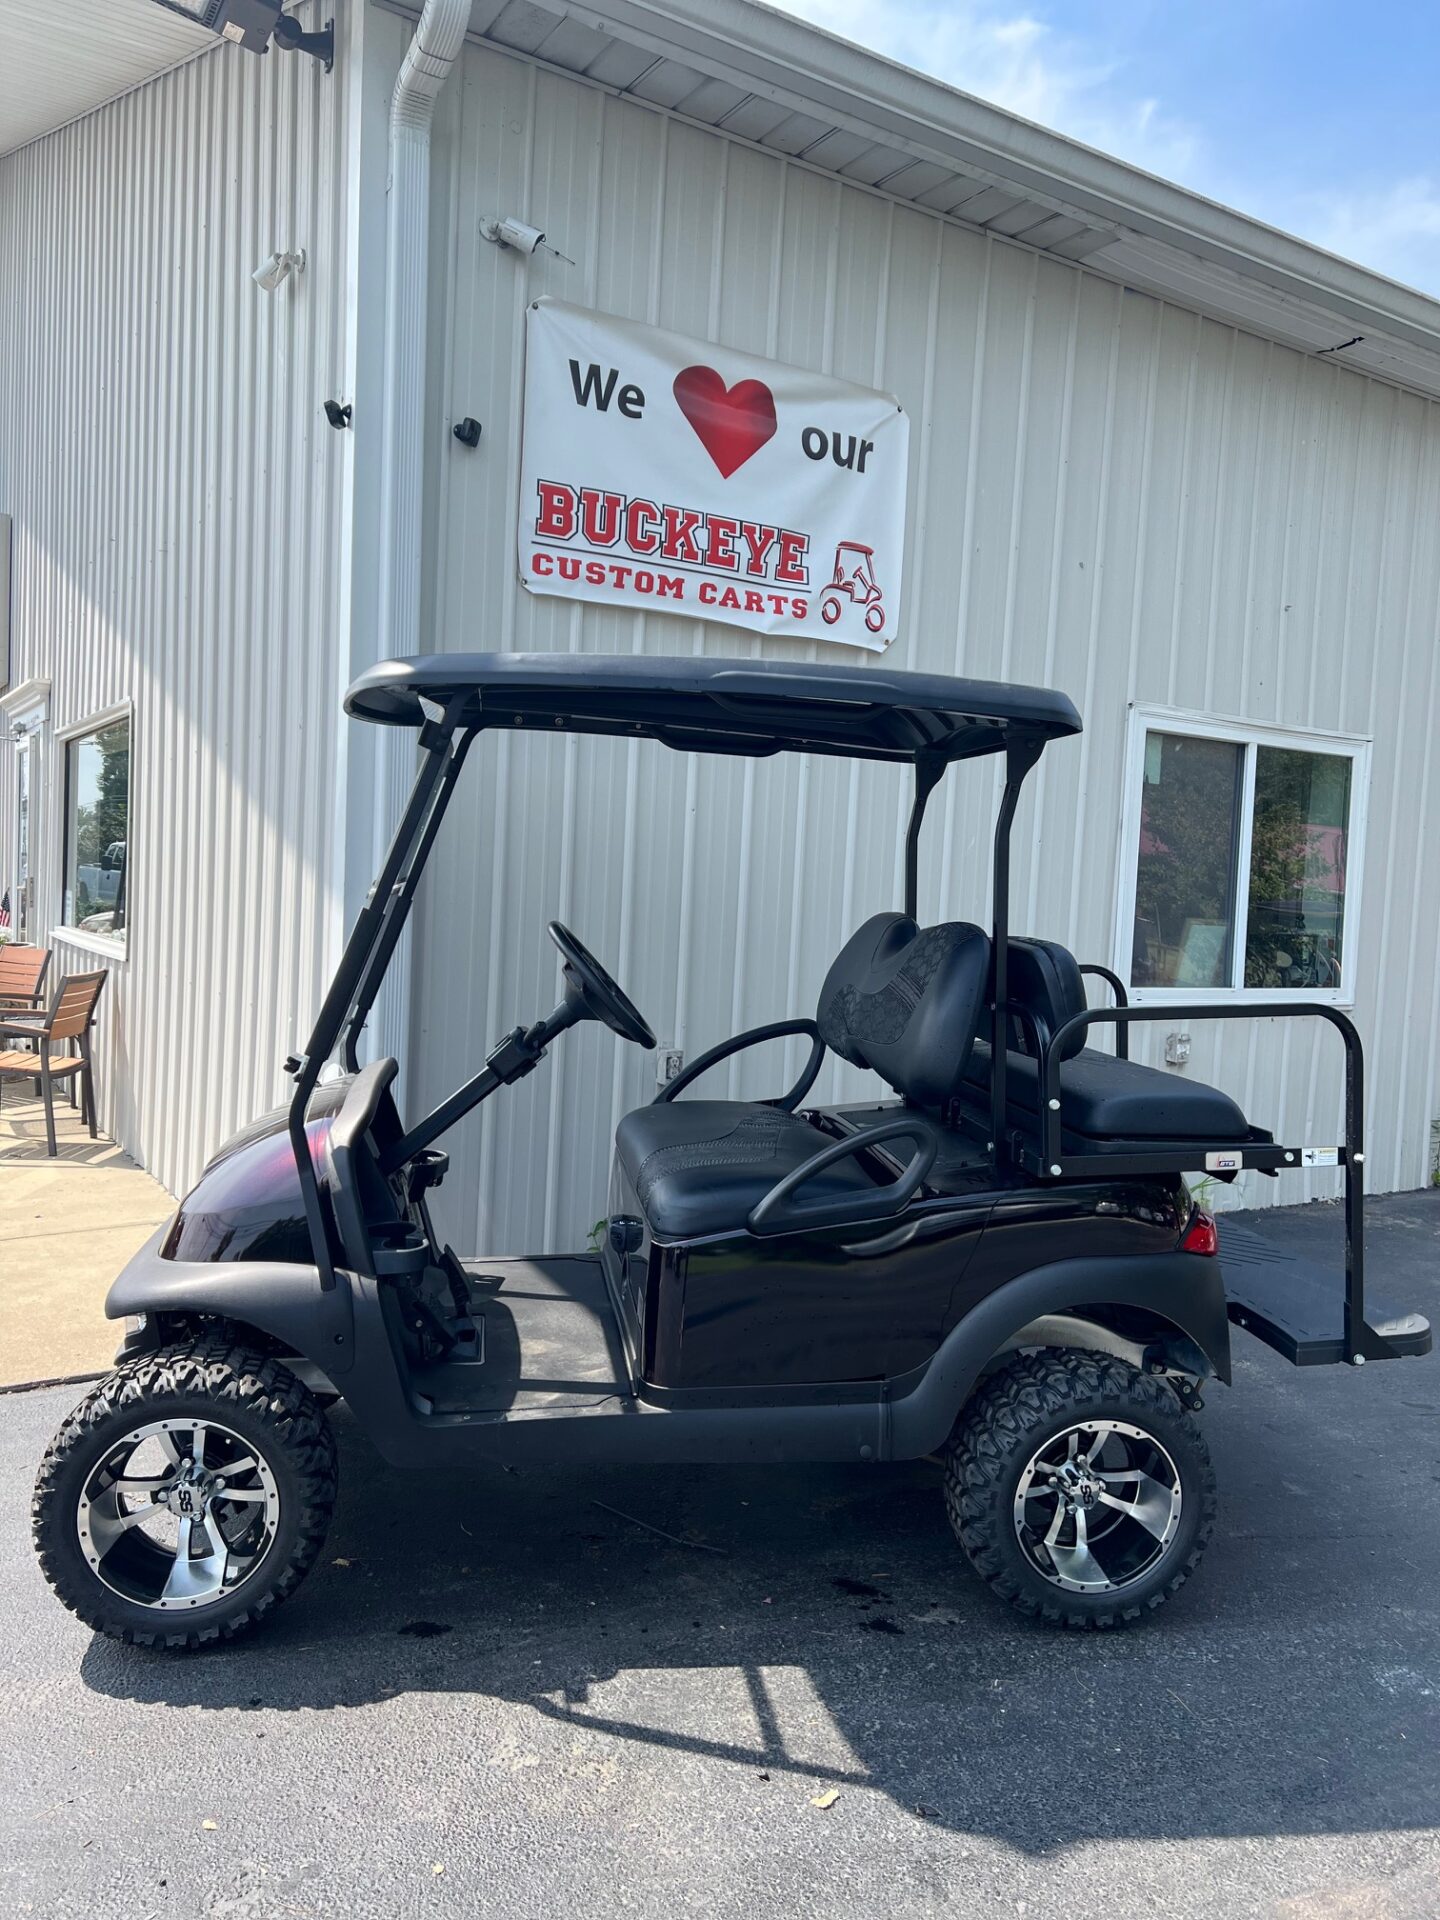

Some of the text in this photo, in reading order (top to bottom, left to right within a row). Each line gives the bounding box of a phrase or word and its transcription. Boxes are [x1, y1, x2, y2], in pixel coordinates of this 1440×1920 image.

[569, 359, 645, 419] We
[802, 427, 873, 473] our
[535, 479, 810, 585] BUCKEYE
[531, 553, 808, 619] CUSTOM CARTS
